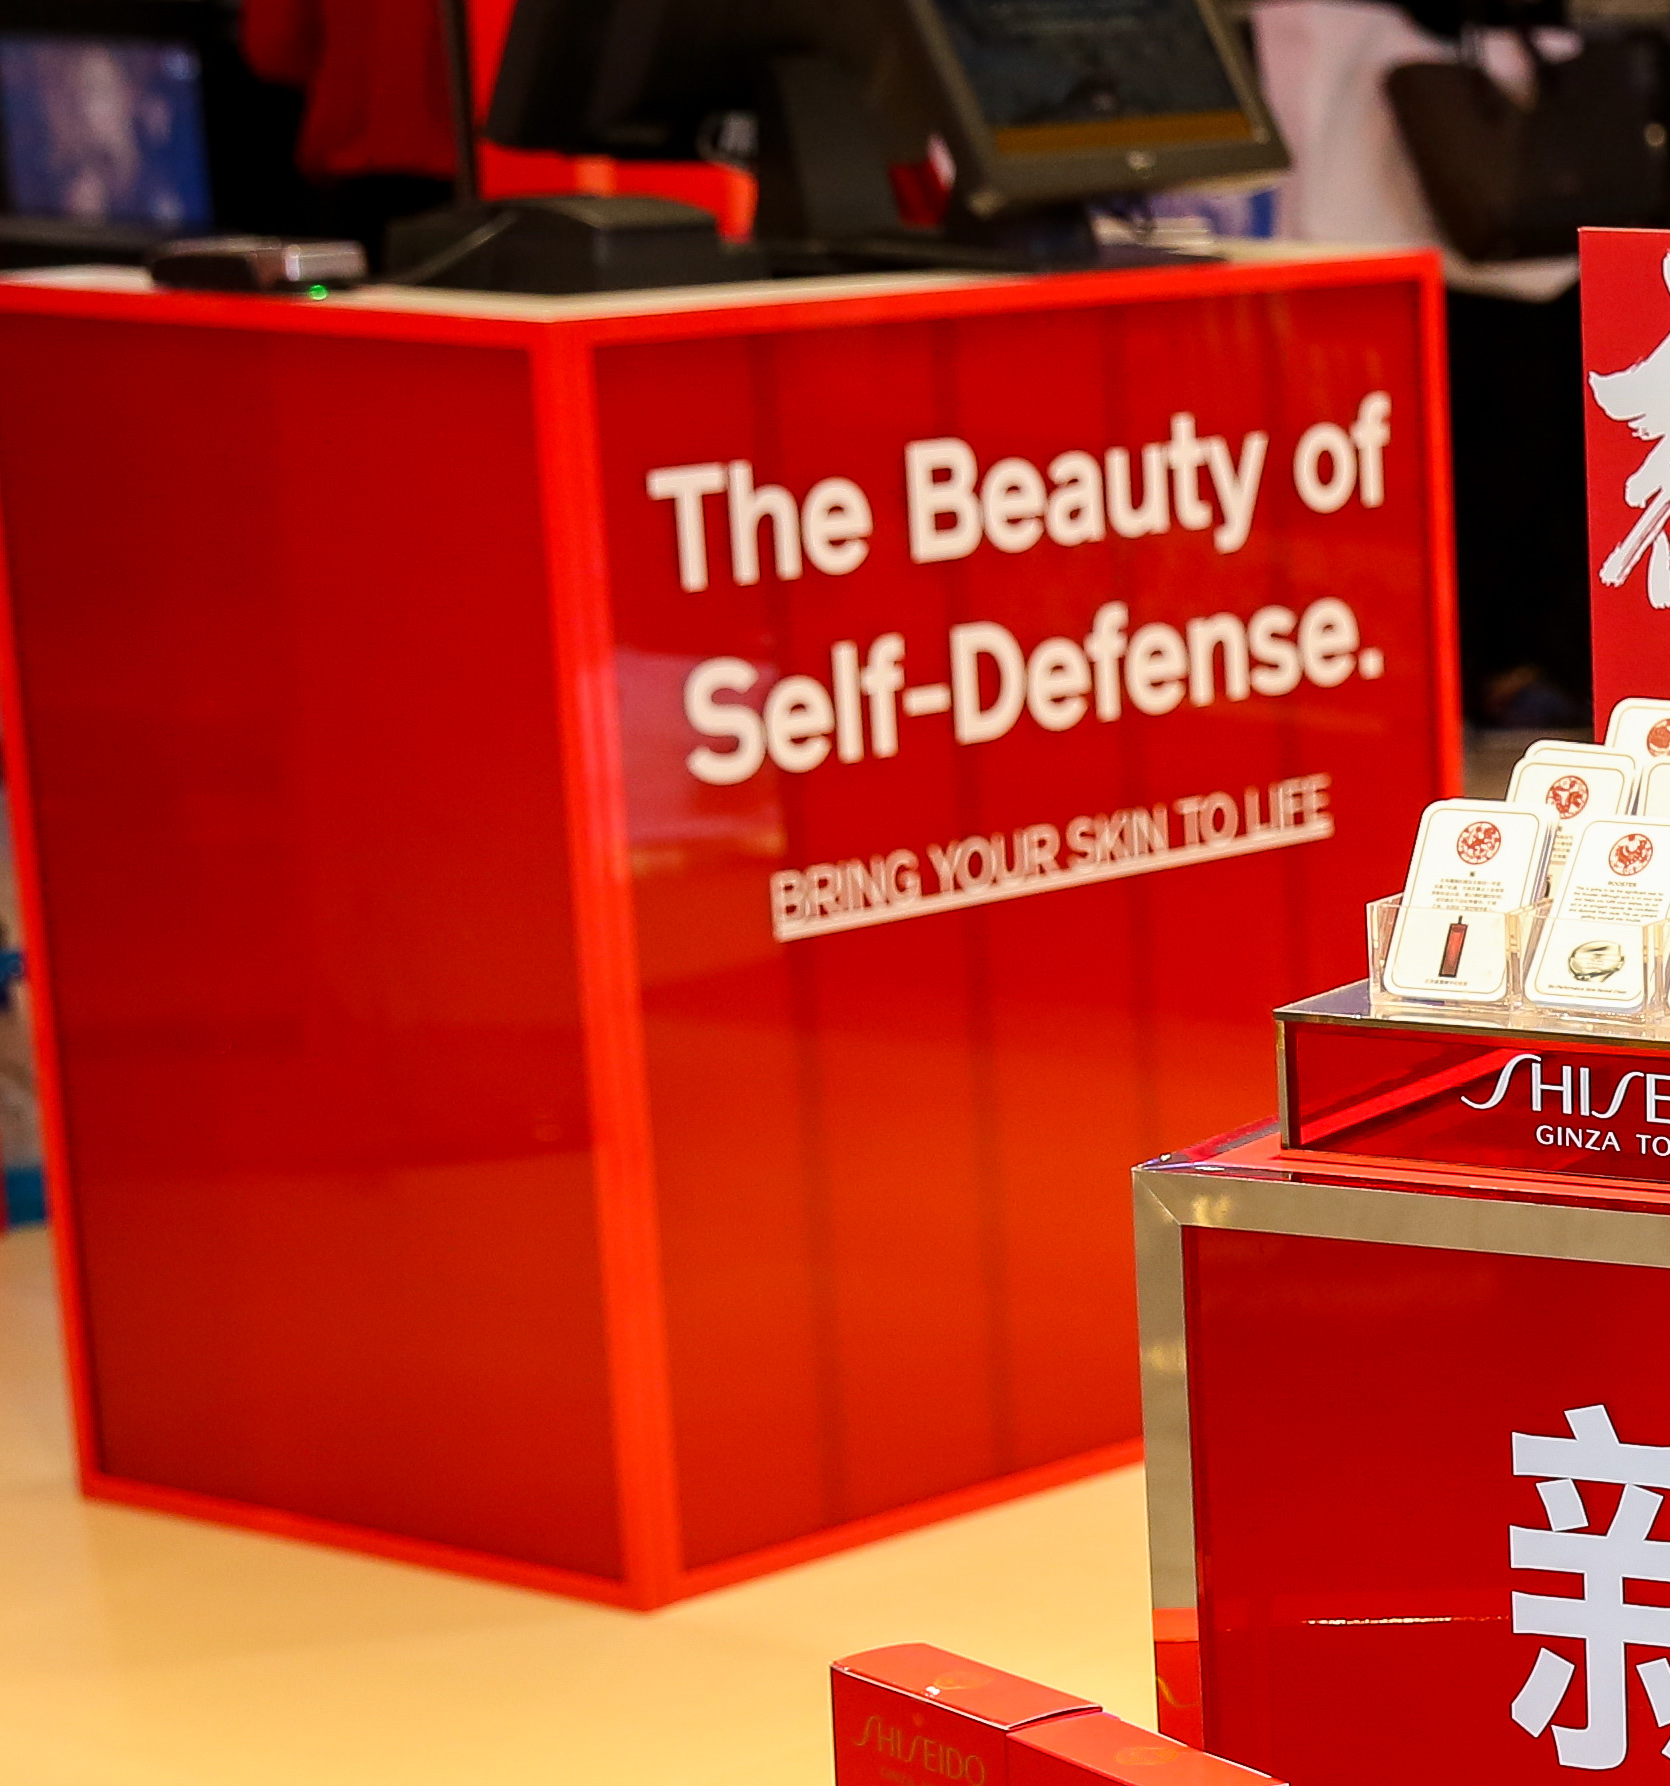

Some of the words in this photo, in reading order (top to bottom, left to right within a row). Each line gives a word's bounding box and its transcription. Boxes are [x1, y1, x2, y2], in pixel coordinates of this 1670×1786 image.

[646, 458, 873, 593] The
[904, 411, 1269, 556] Beauty
[1292, 389, 1393, 514] of
[682, 596, 1385, 787] Self-Defense.
[770, 848, 922, 926] BRING
[928, 821, 1060, 897] YOUR
[1066, 802, 1168, 873] SKIN
[1175, 791, 1239, 849] TO
[1245, 772, 1332, 834] LIFE
[1535, 1124, 1621, 1152] GINZA
